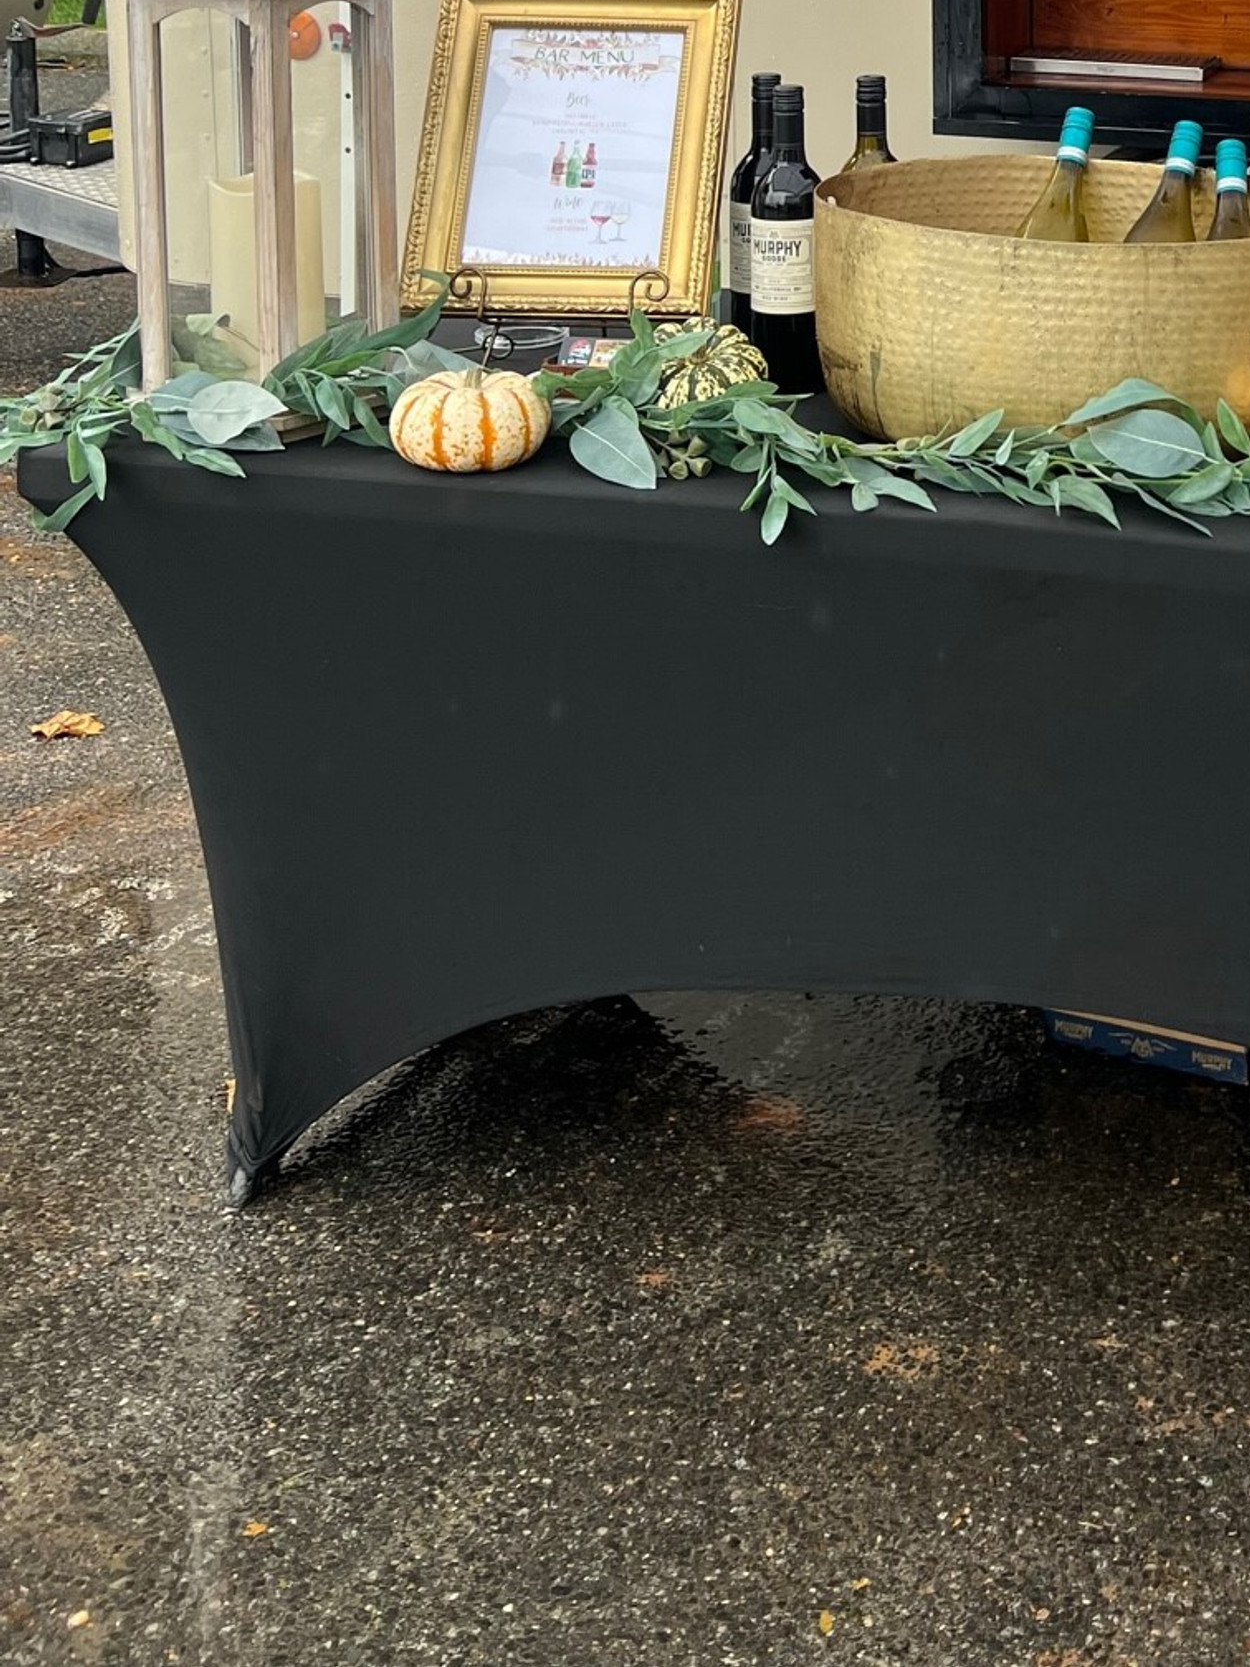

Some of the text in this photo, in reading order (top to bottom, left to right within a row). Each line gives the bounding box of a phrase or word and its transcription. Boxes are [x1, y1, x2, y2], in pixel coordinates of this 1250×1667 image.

[534, 47, 635, 66] BAR MENU
[754, 239, 802, 258] MURPHY
